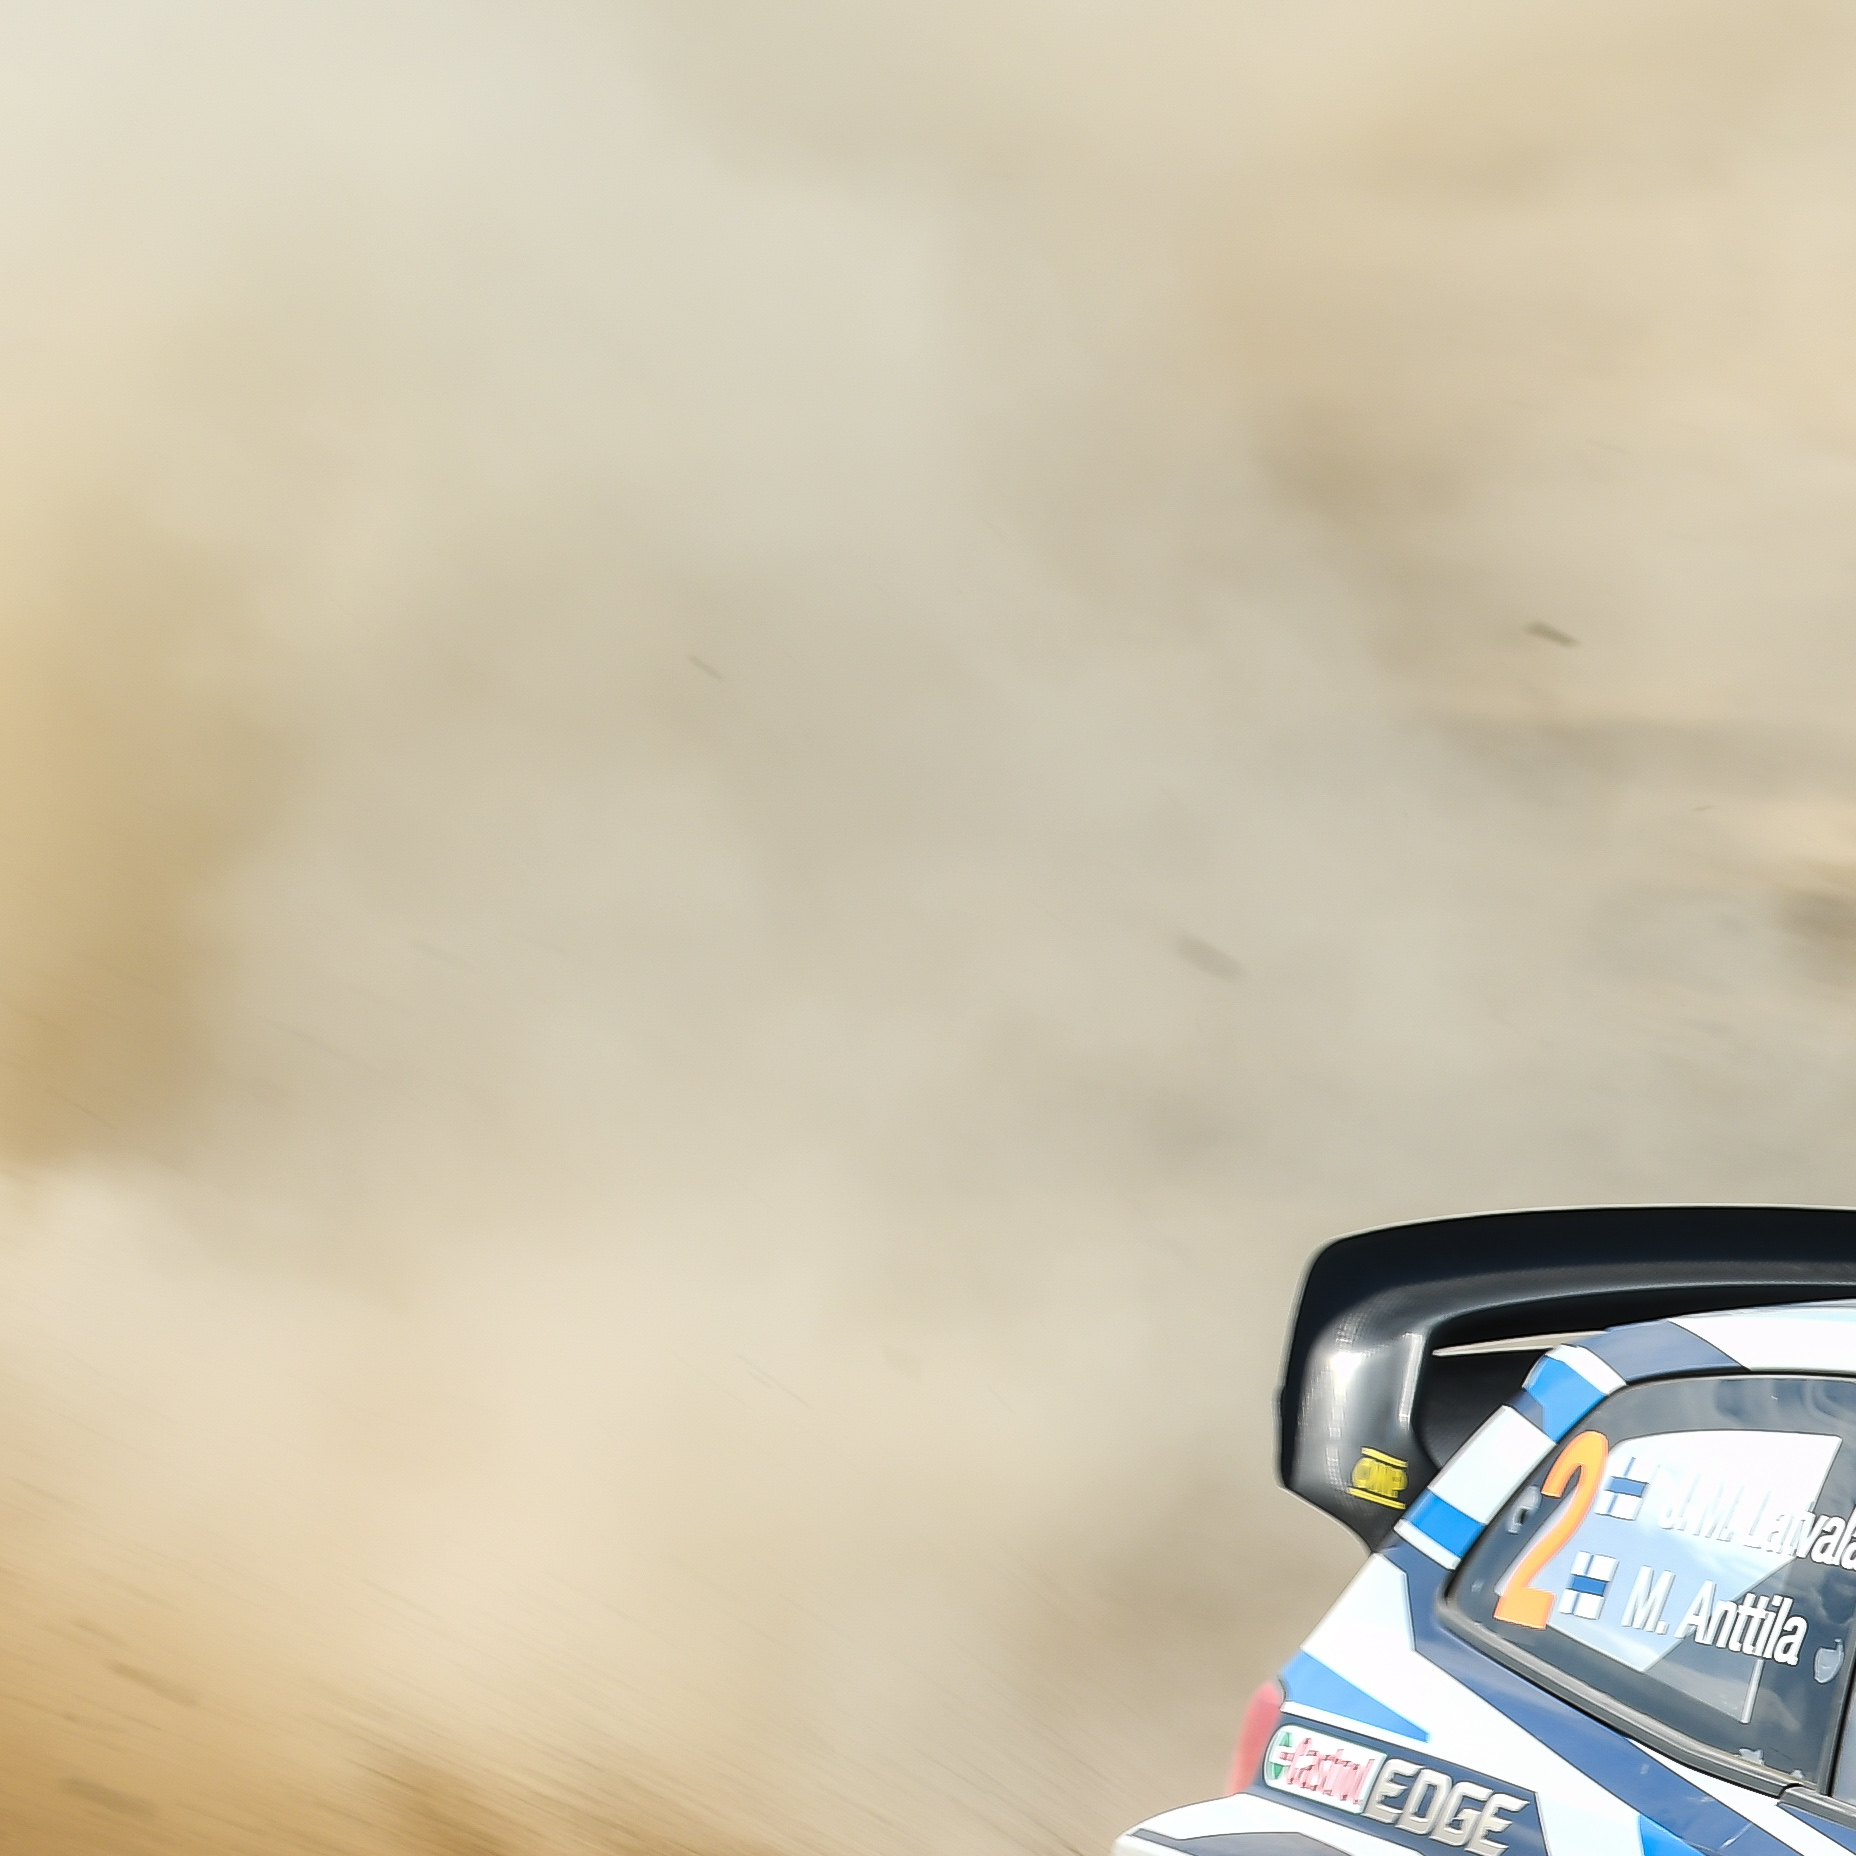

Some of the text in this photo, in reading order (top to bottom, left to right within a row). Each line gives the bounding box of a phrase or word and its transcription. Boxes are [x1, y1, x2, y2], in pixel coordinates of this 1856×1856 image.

[1494, 1430, 1609, 1629] 2
[1620, 1565, 1809, 1666] M. Anttila
